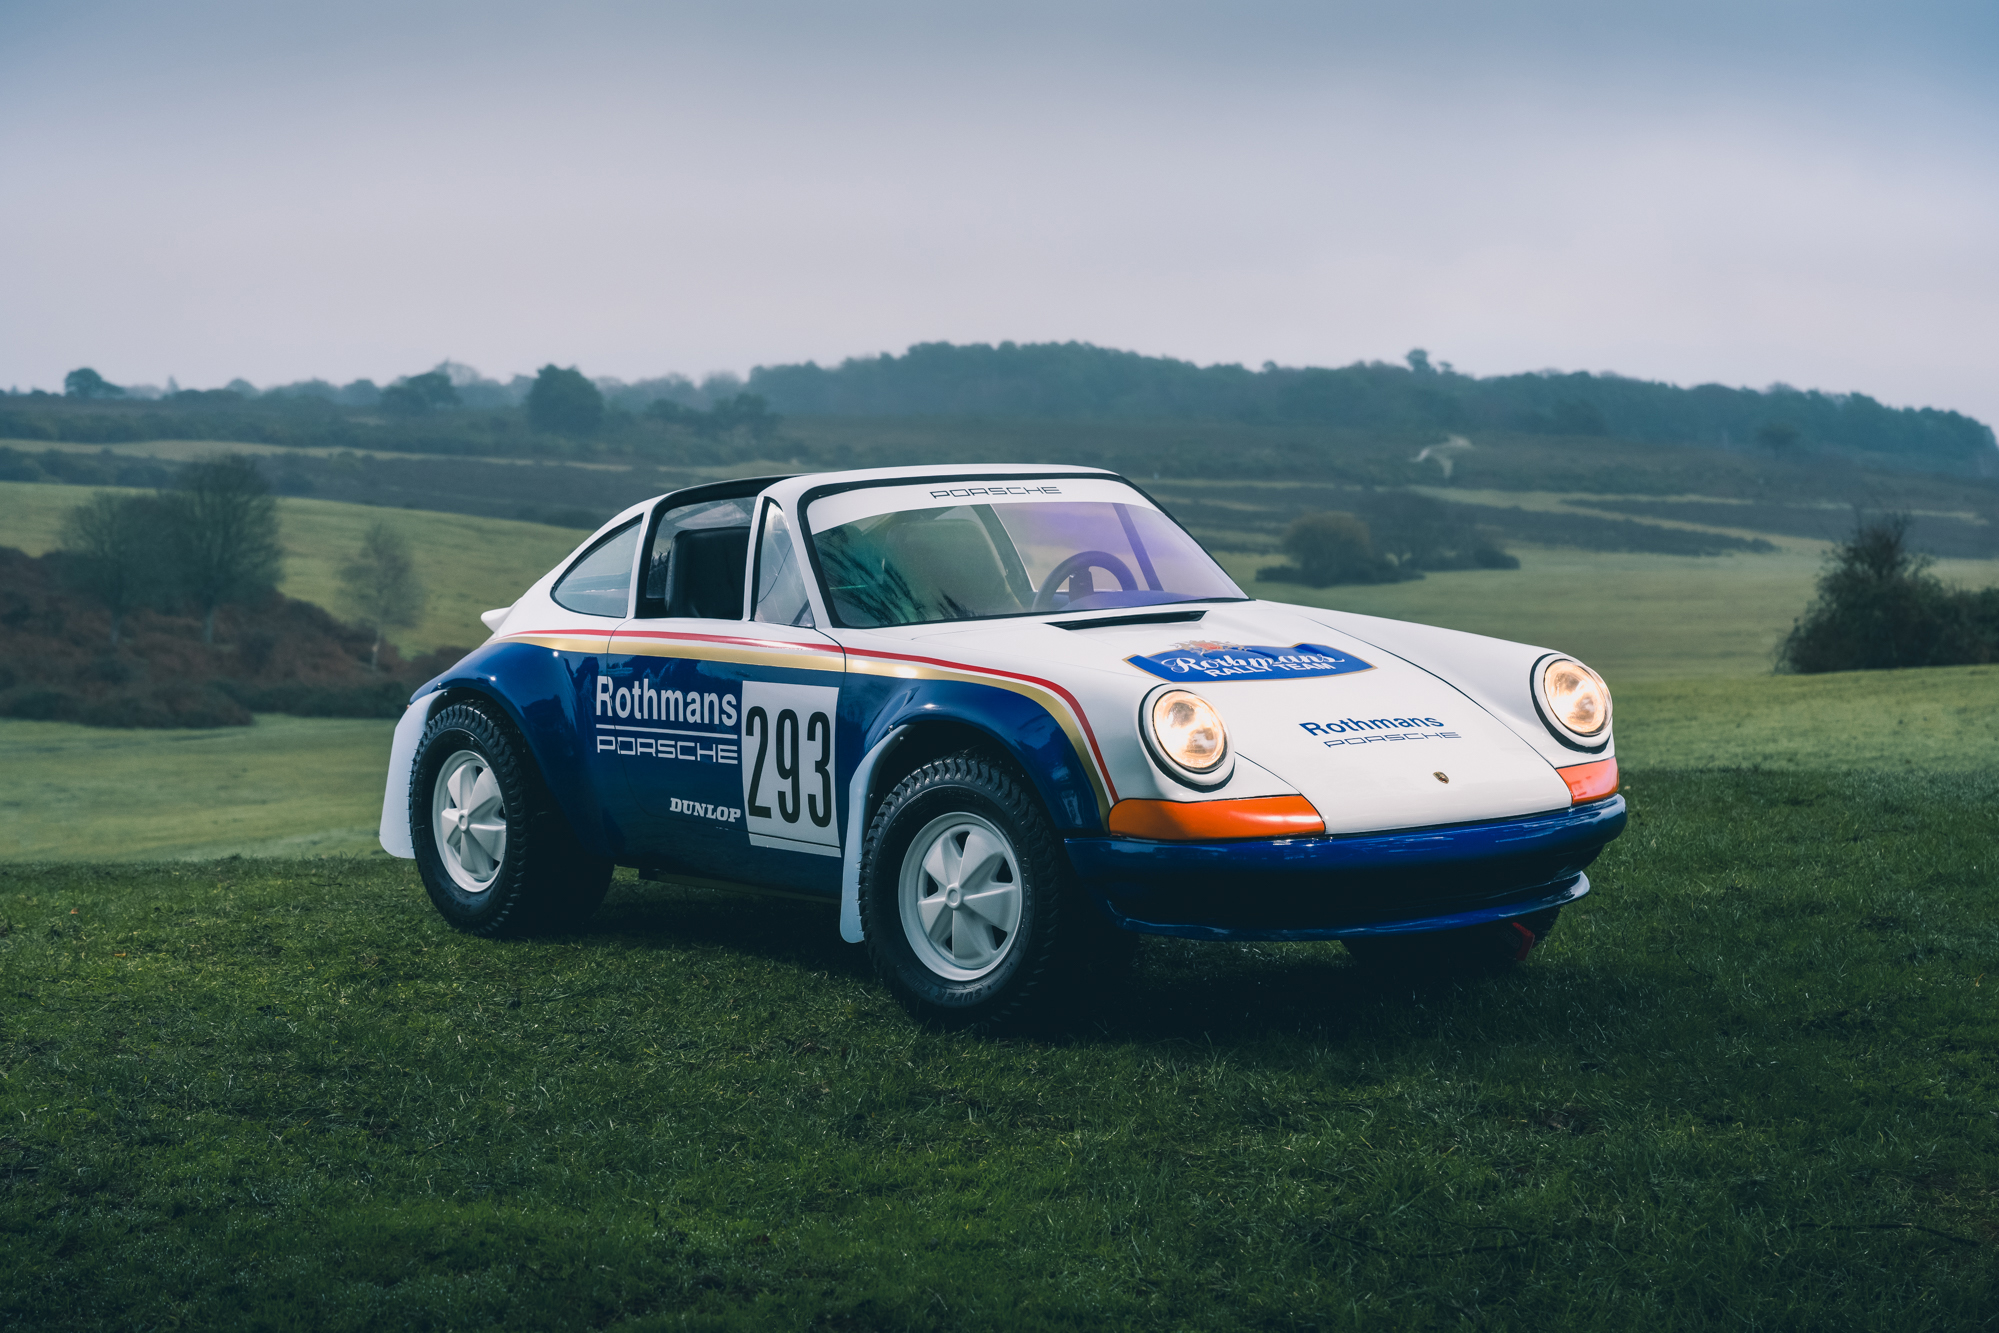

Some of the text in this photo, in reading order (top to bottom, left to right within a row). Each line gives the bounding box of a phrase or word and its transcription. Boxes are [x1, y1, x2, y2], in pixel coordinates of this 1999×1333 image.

[929, 486, 1062, 499] PORSCHE
[1203, 662, 1337, 677] RALLY TEAM
[595, 675, 738, 727] Rothmans
[1299, 714, 1445, 737] Rothmans
[596, 735, 738, 765] PORSCHE
[1323, 731, 1462, 748] PORSCHE
[745, 705, 832, 828] 293
[670, 797, 741, 822] DUNLOP
[934, 988, 983, 1004] SUPER
